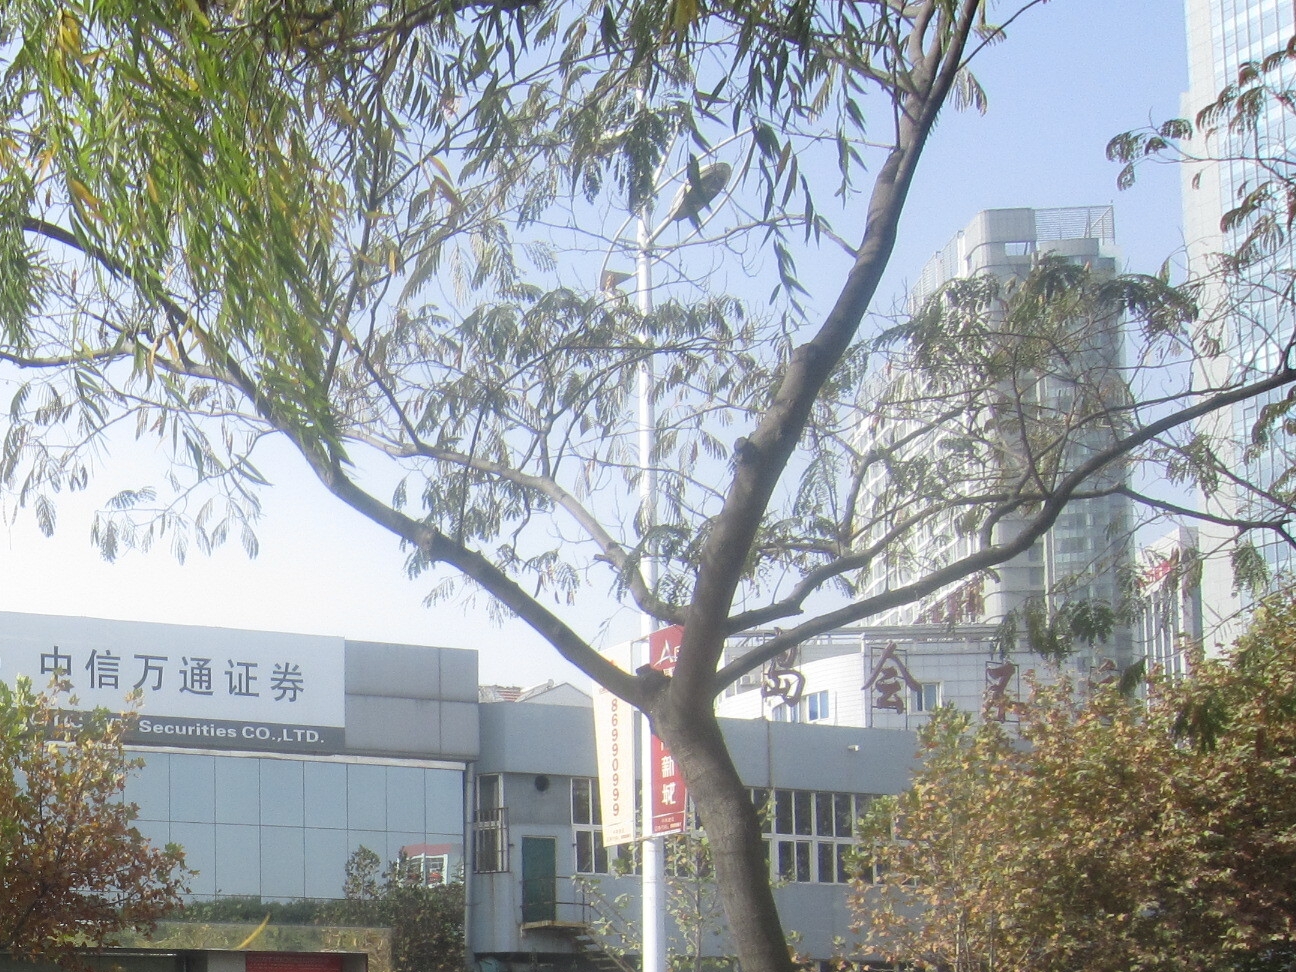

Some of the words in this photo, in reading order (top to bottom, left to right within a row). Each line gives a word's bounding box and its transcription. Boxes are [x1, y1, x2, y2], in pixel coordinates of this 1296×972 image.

[40, 645, 305, 702] 中信万通证券
[138, 719, 237, 738] Securities
[242, 726, 325, 743] CO.,LTD.
[610, 698, 620, 817] 86990999
[660, 742, 677, 806] 新城
